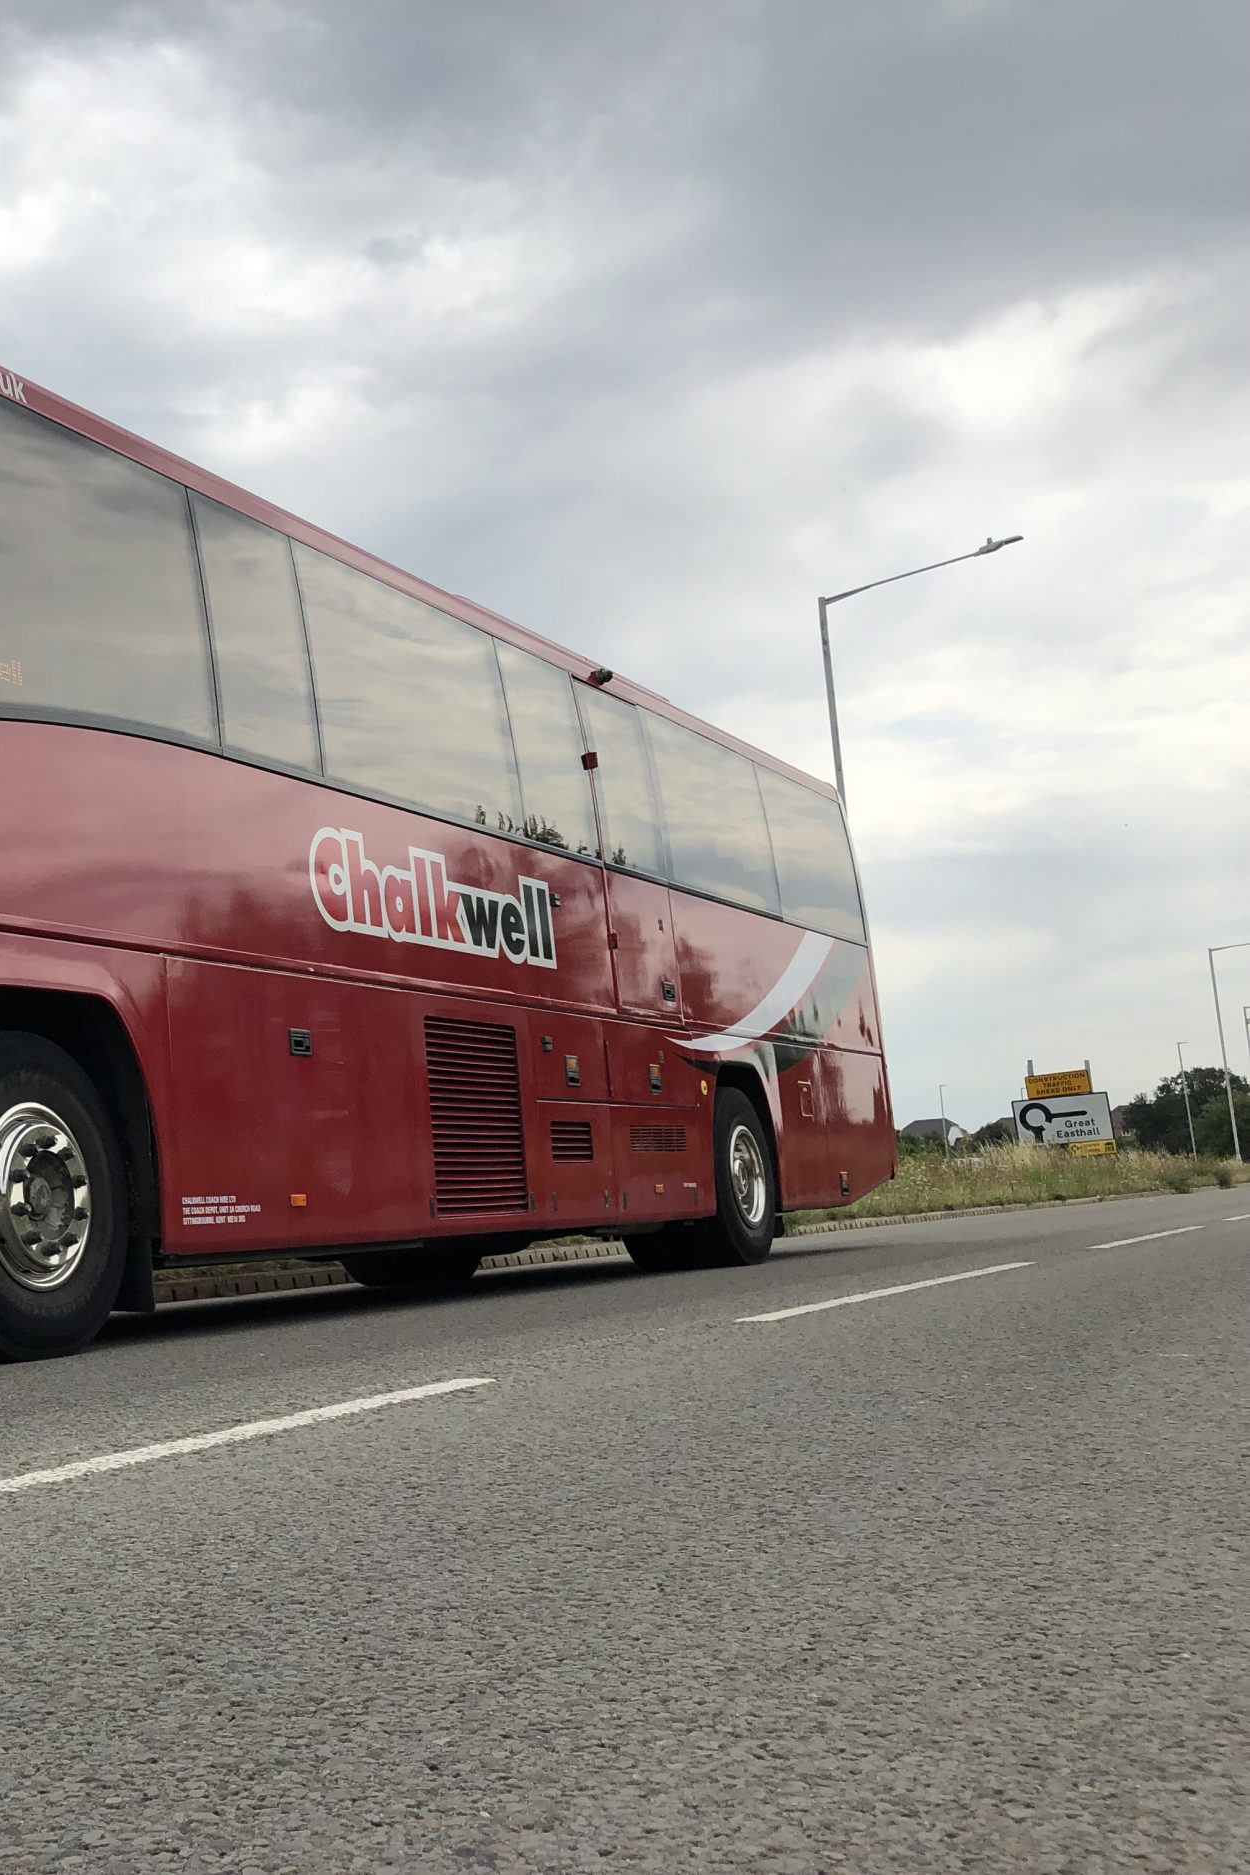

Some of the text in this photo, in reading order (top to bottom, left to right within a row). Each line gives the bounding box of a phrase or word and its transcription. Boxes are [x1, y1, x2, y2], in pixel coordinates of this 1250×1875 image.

[309, 827, 557, 969] Chalkwell
[1028, 1071, 1086, 1084] CONSTRUCTION
[1036, 1084, 1081, 1095] AHEAD ONLY
[1042, 1080, 1073, 1088] TRAFFIC
[1064, 1118, 1096, 1129] Great
[1056, 1127, 1101, 1139] Easthall
[205, 1195, 220, 1204] COACH
[182, 1207, 191, 1215] THE
[191, 1206, 205, 1215] COACH
